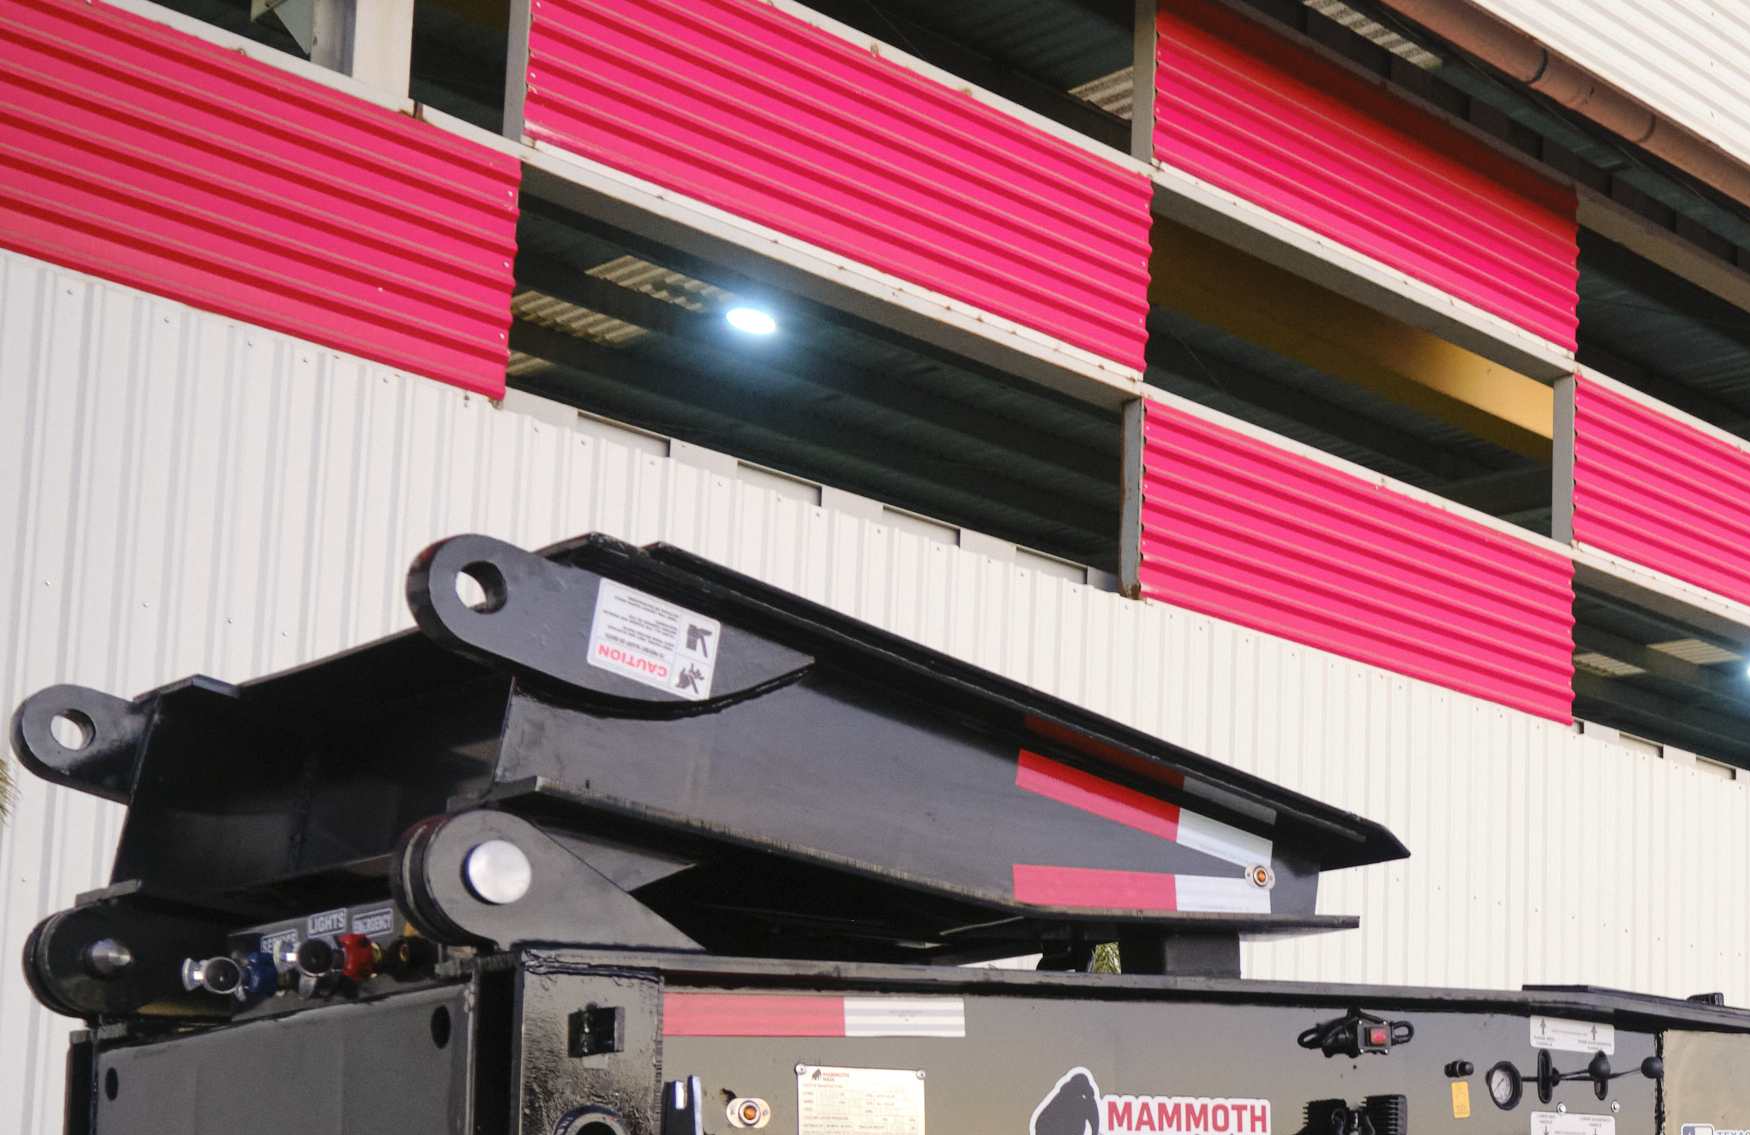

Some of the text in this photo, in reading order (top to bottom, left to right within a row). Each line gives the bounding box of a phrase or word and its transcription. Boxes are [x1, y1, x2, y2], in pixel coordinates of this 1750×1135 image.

[598, 644, 667, 677] CAUTION
[308, 911, 345, 934] LIGHTS
[354, 914, 391, 934] EMERGENCY
[1108, 1101, 1267, 1133] MAMMOTH
